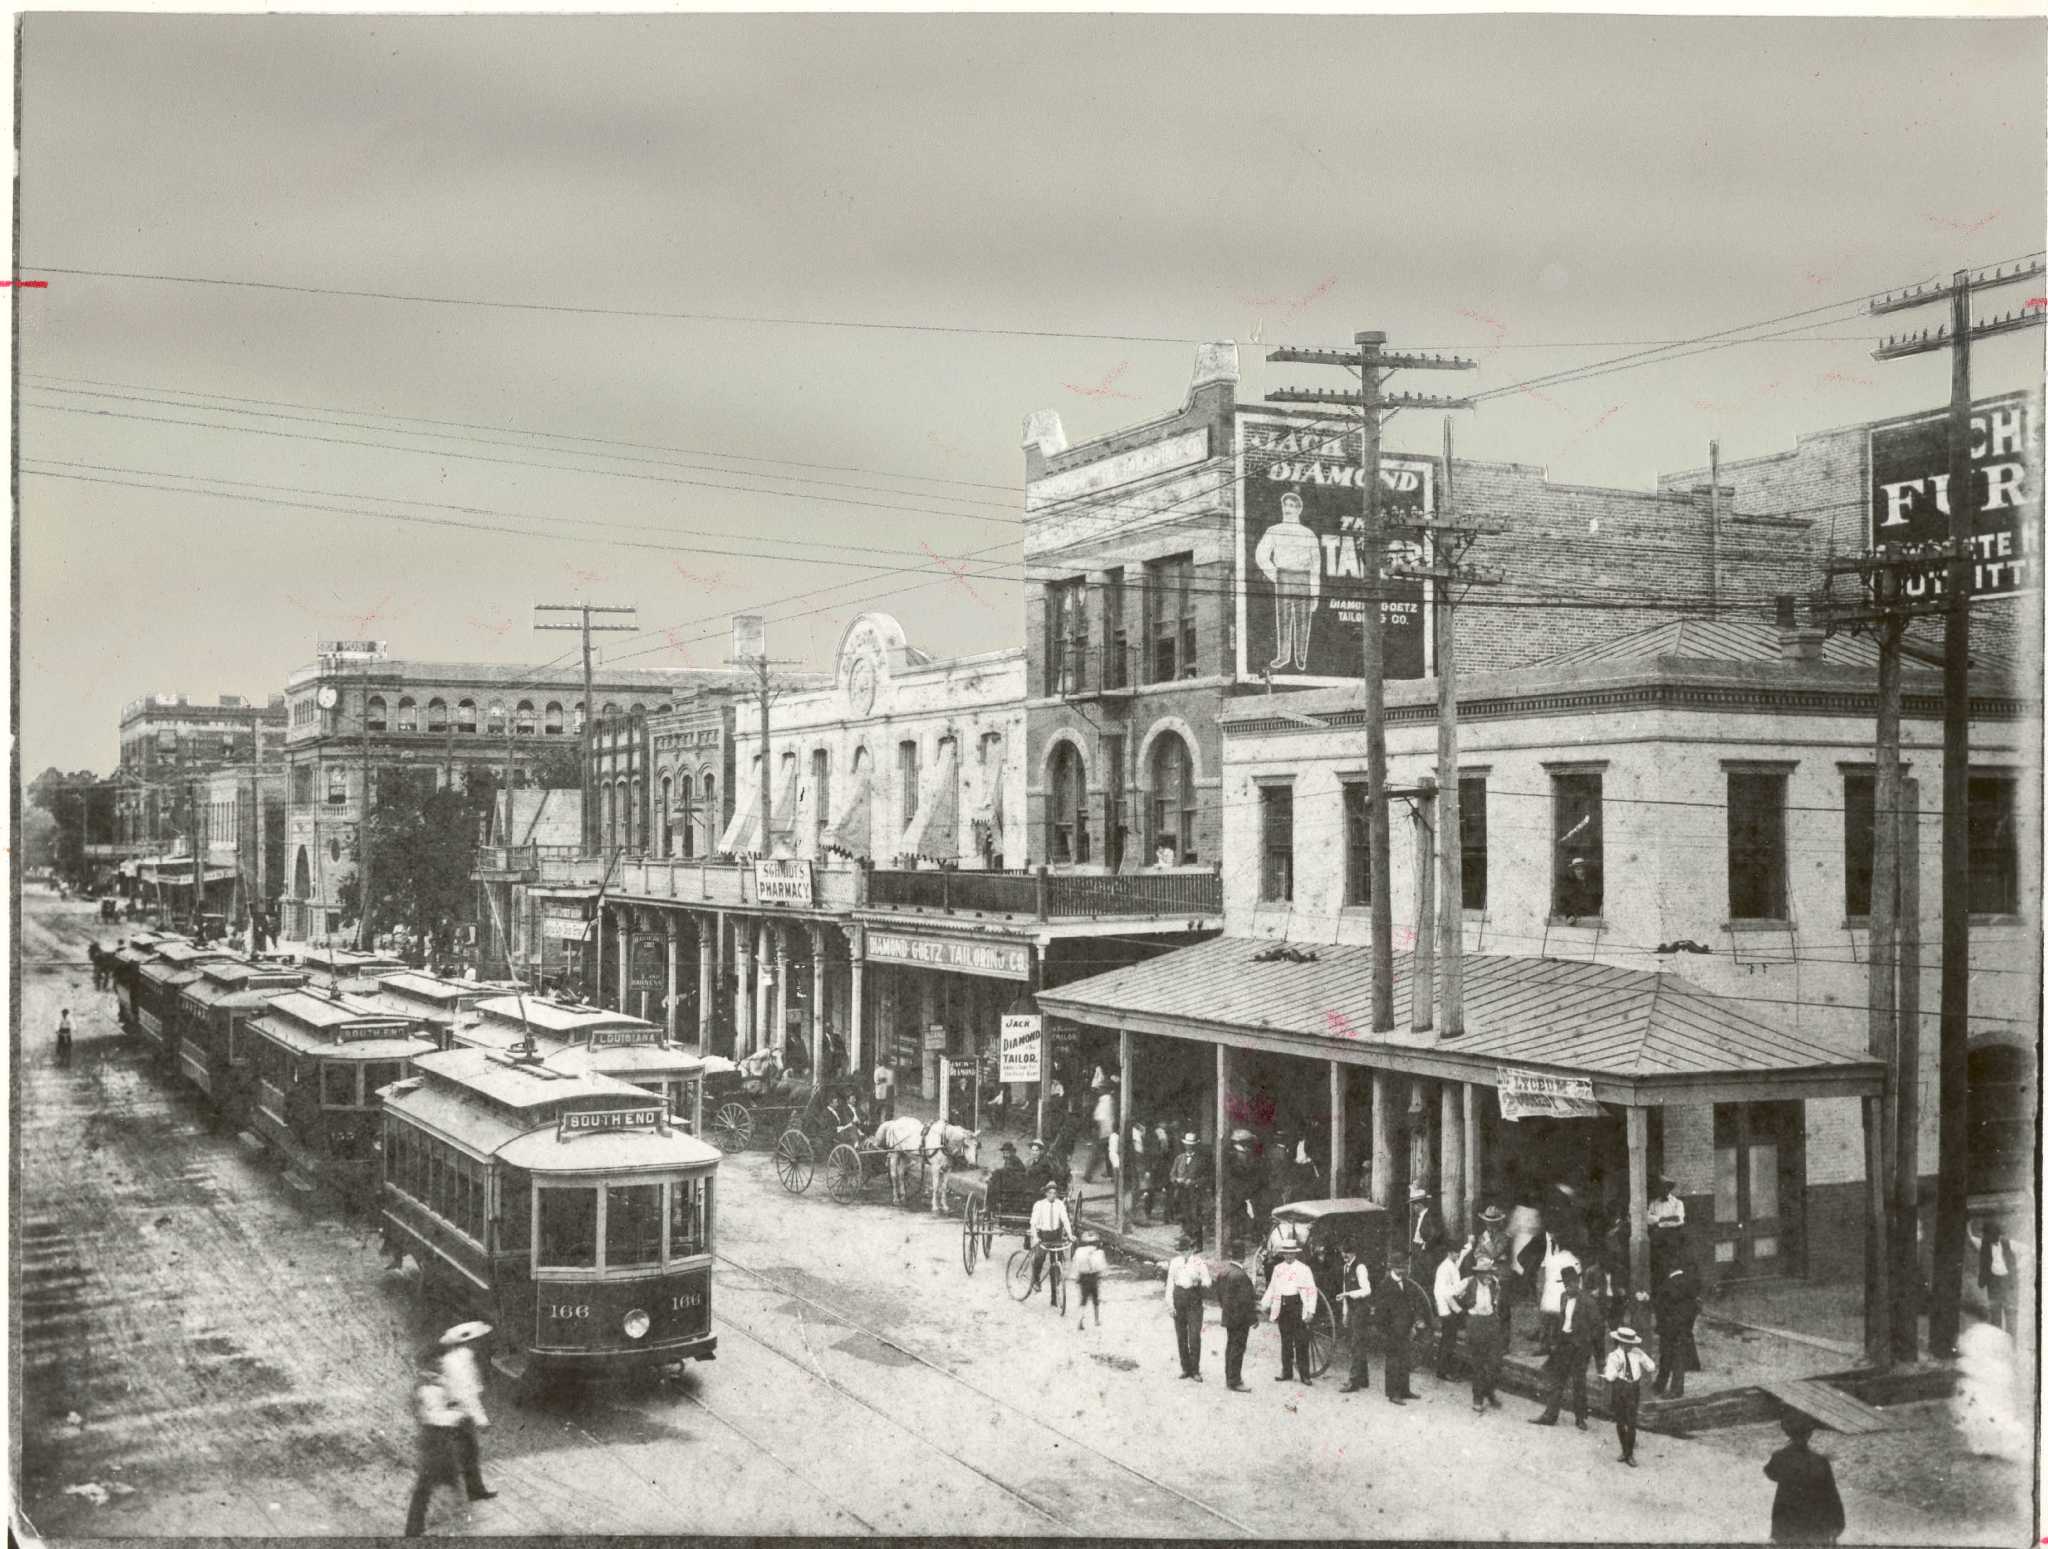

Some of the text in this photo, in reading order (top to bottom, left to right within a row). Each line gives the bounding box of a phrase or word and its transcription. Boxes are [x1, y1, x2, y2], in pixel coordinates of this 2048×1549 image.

[1321, 534, 1424, 582] TAOR
[759, 881, 810, 899] PHARMACY
[1005, 1018, 1031, 1028] JACK
[1003, 1029, 1041, 1052] DIAMOND
[570, 1111, 655, 1129] SOUTH END
[551, 1304, 590, 1319] 166
[672, 1294, 701, 1311] 166
